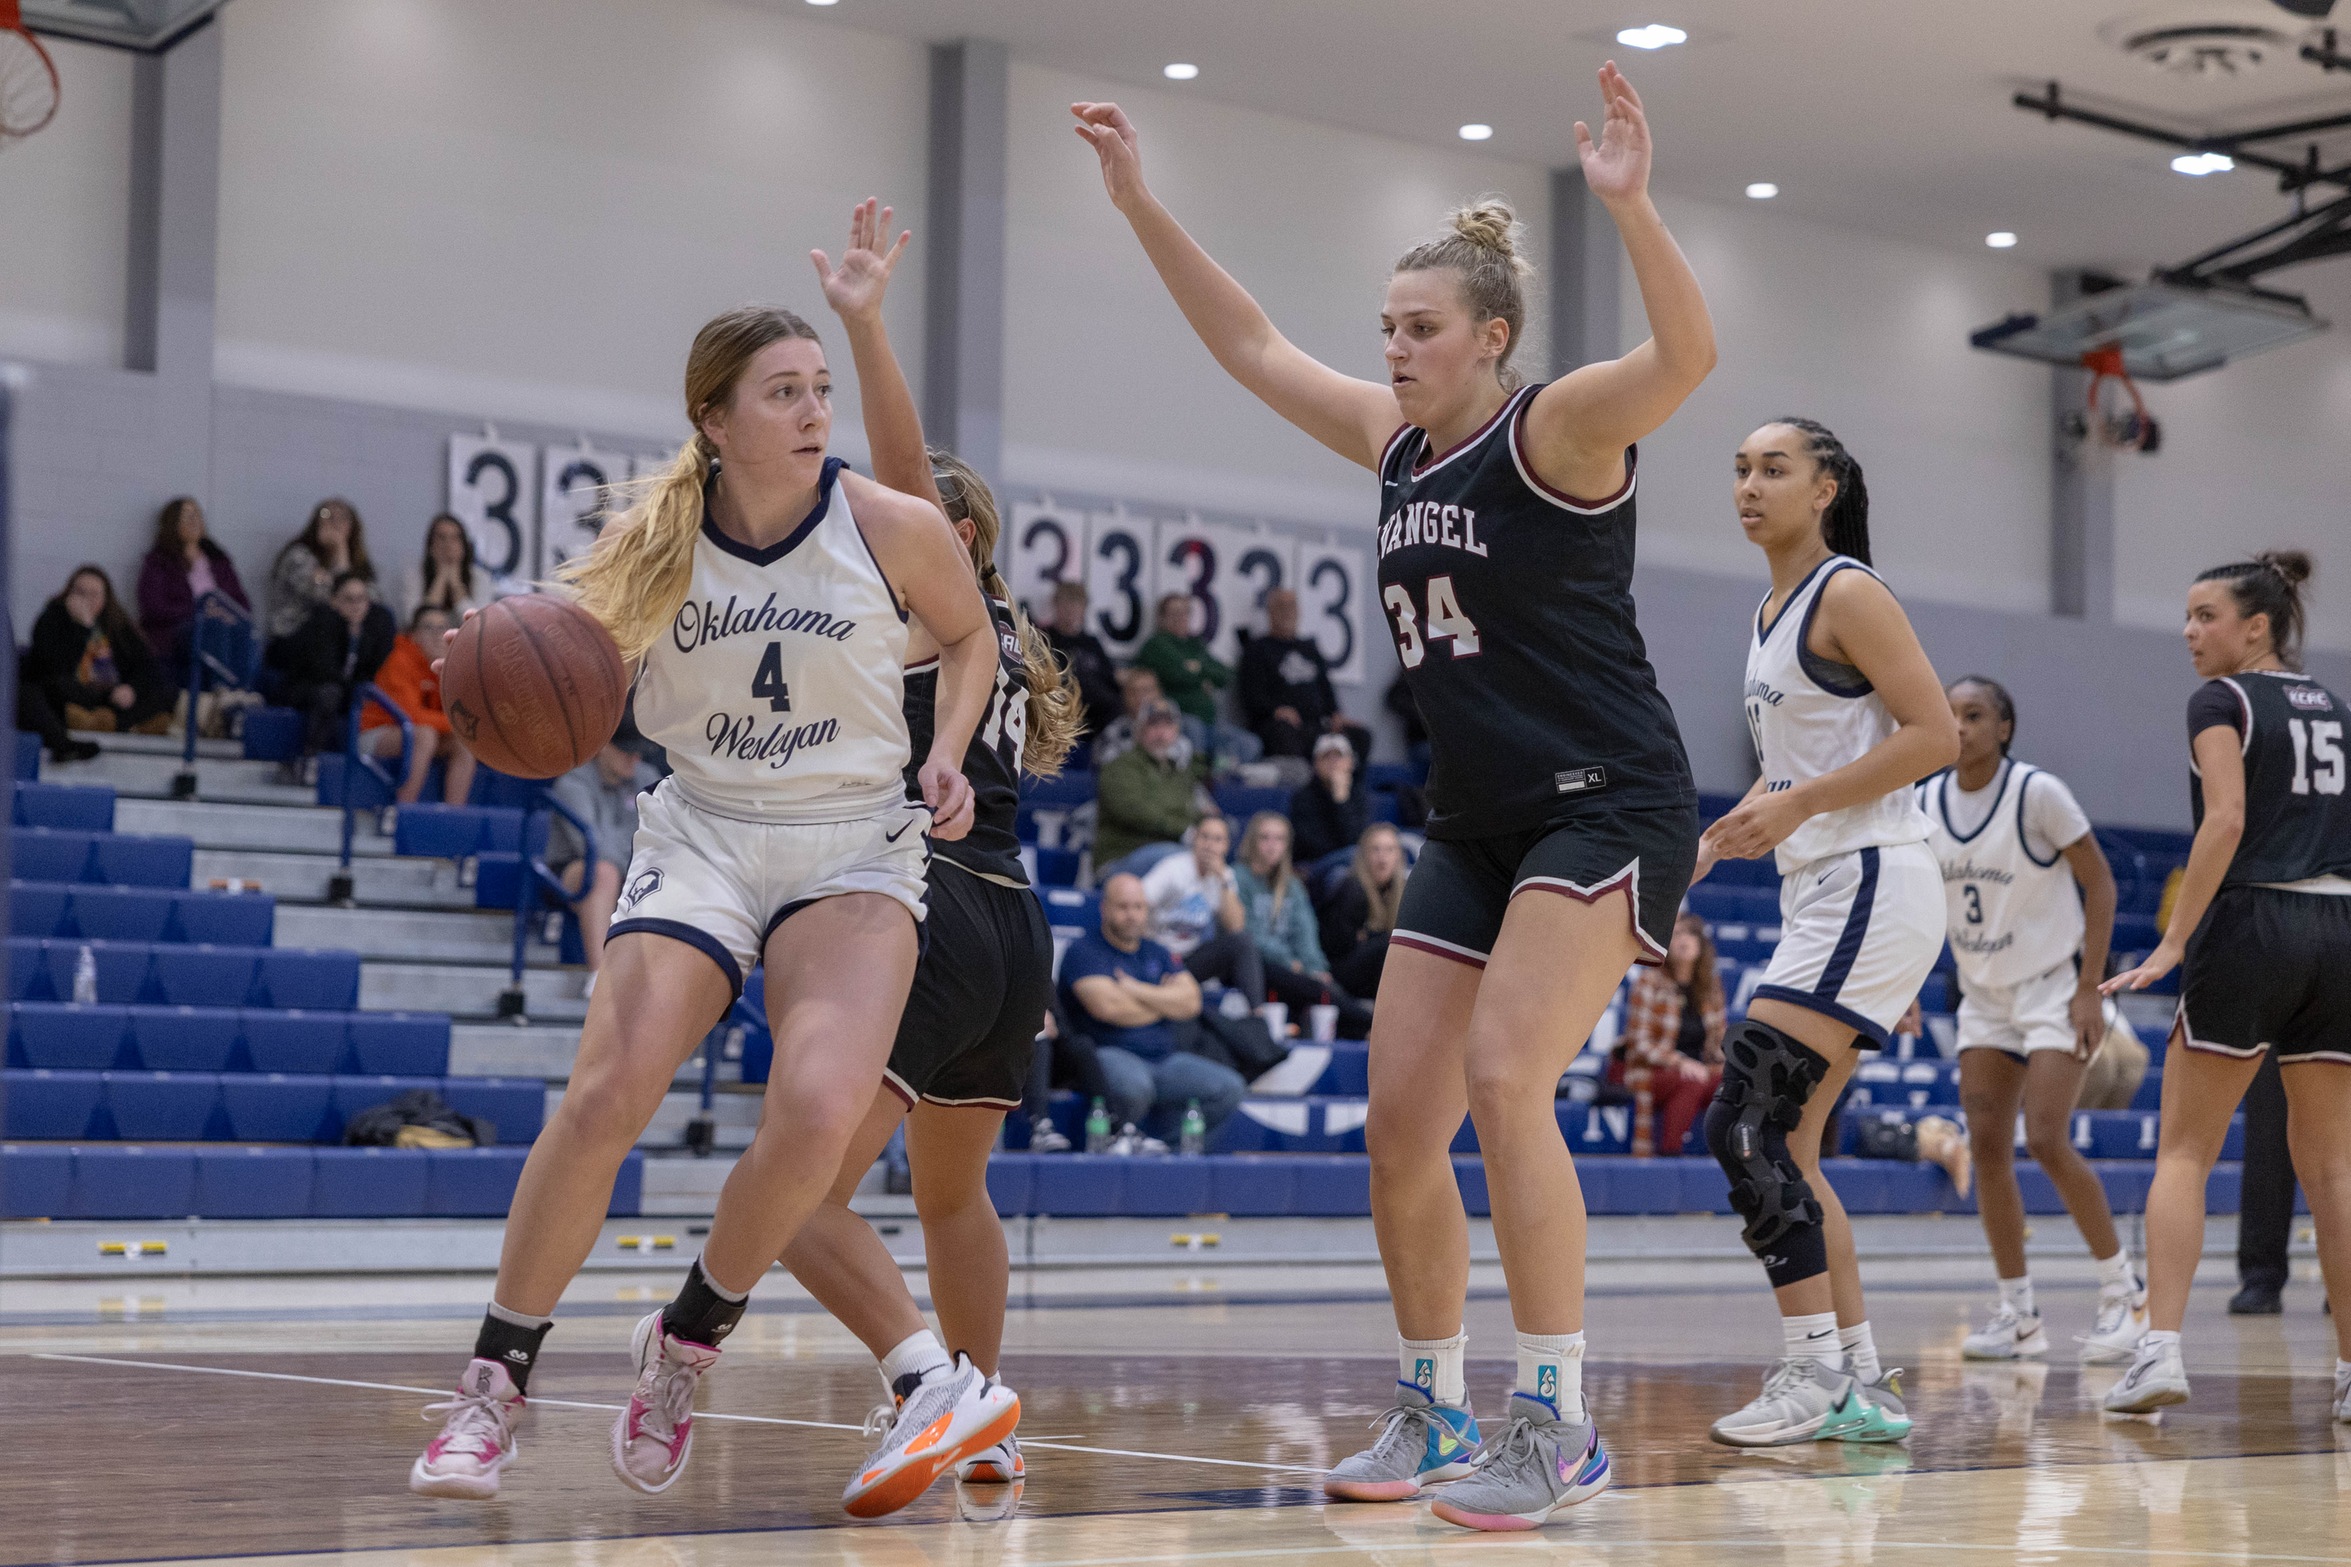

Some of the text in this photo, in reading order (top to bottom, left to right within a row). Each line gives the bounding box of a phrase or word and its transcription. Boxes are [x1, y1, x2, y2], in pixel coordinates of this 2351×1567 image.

[466, 452, 521, 577] 3
[1377, 501, 1488, 558] VANGEL
[673, 592, 857, 653] Oklahoma
[1098, 530, 1143, 643] 3
[1309, 558, 1353, 669] 3
[1383, 573, 1483, 671] 34
[751, 641, 791, 712] 4
[982, 658, 1031, 779] 14
[2287, 717, 2346, 796] 15
[1587, 772, 1602, 783] XL
[1963, 883, 1984, 925] 3
